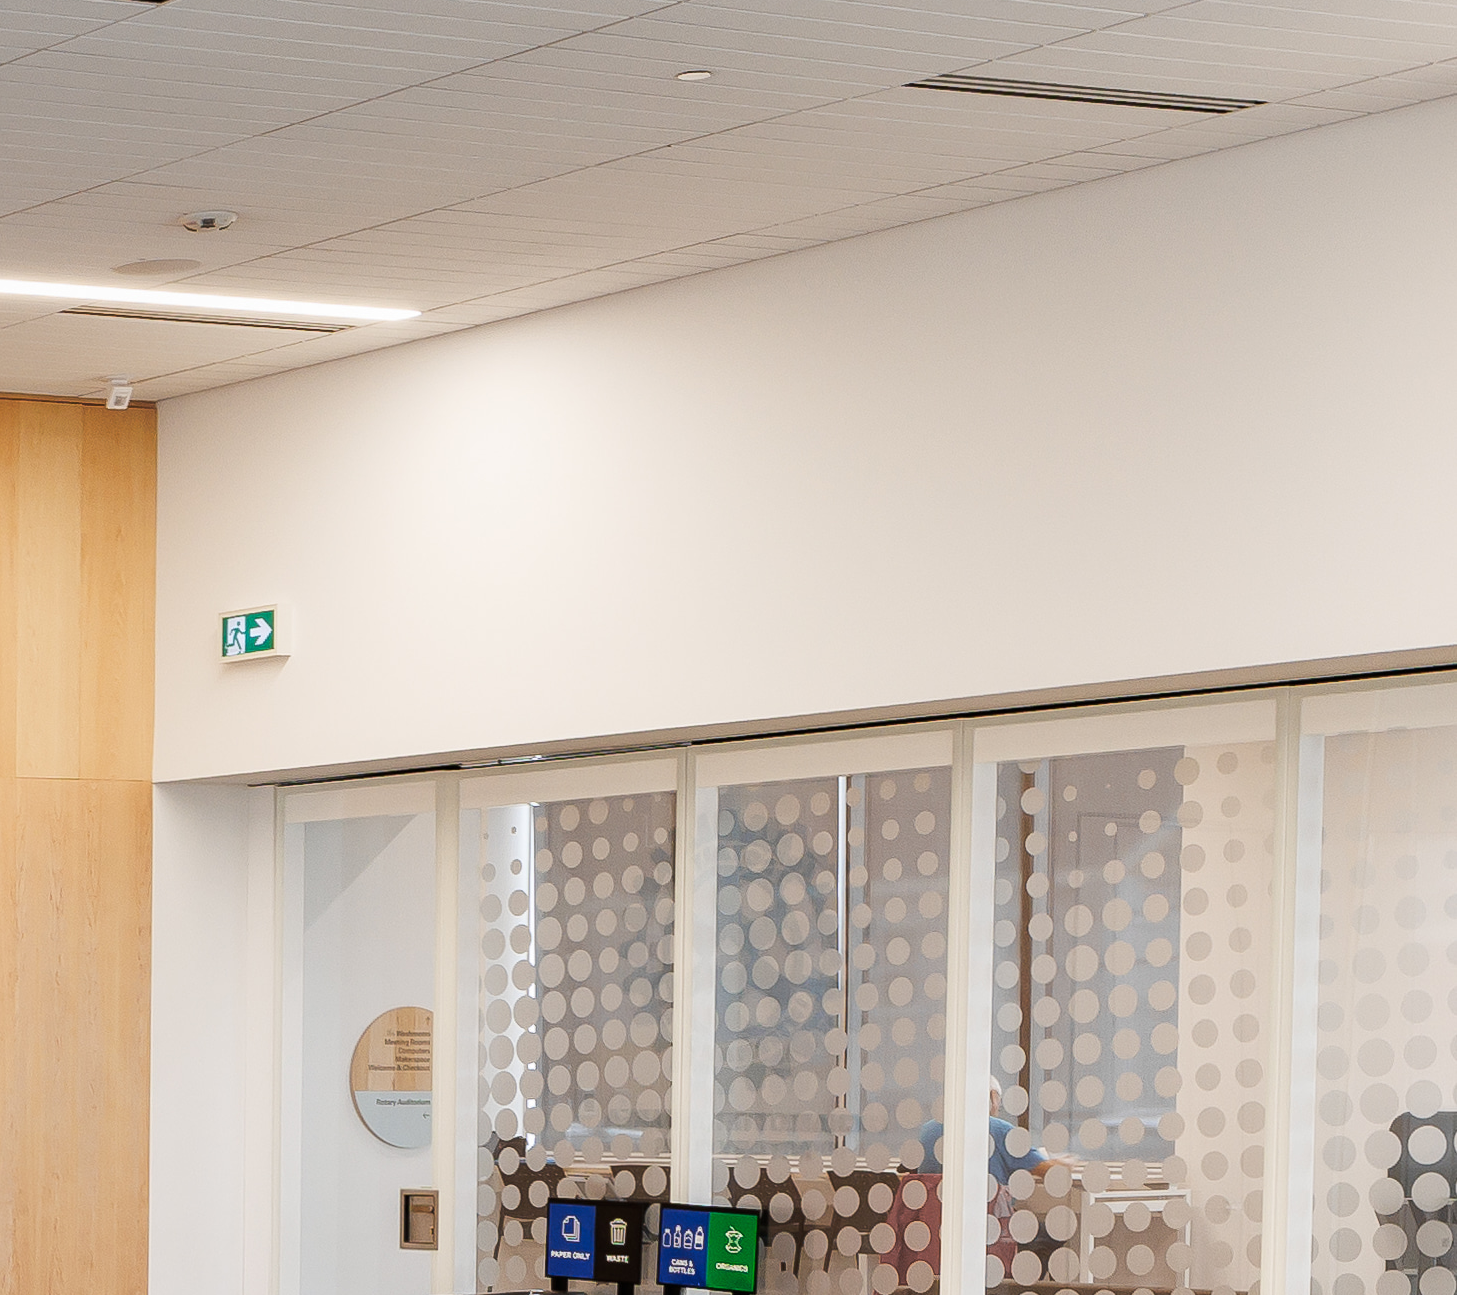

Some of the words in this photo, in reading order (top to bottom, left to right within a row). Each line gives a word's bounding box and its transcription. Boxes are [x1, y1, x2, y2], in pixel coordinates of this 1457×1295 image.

[398, 1047, 430, 1055] Computers
[551, 1250, 571, 1258] PAPER
[573, 1252, 590, 1260] ONLY
[606, 1254, 629, 1263] WASTE
[669, 1266, 695, 1275] BOTTLES
[716, 1263, 748, 1273] ORGANICS
